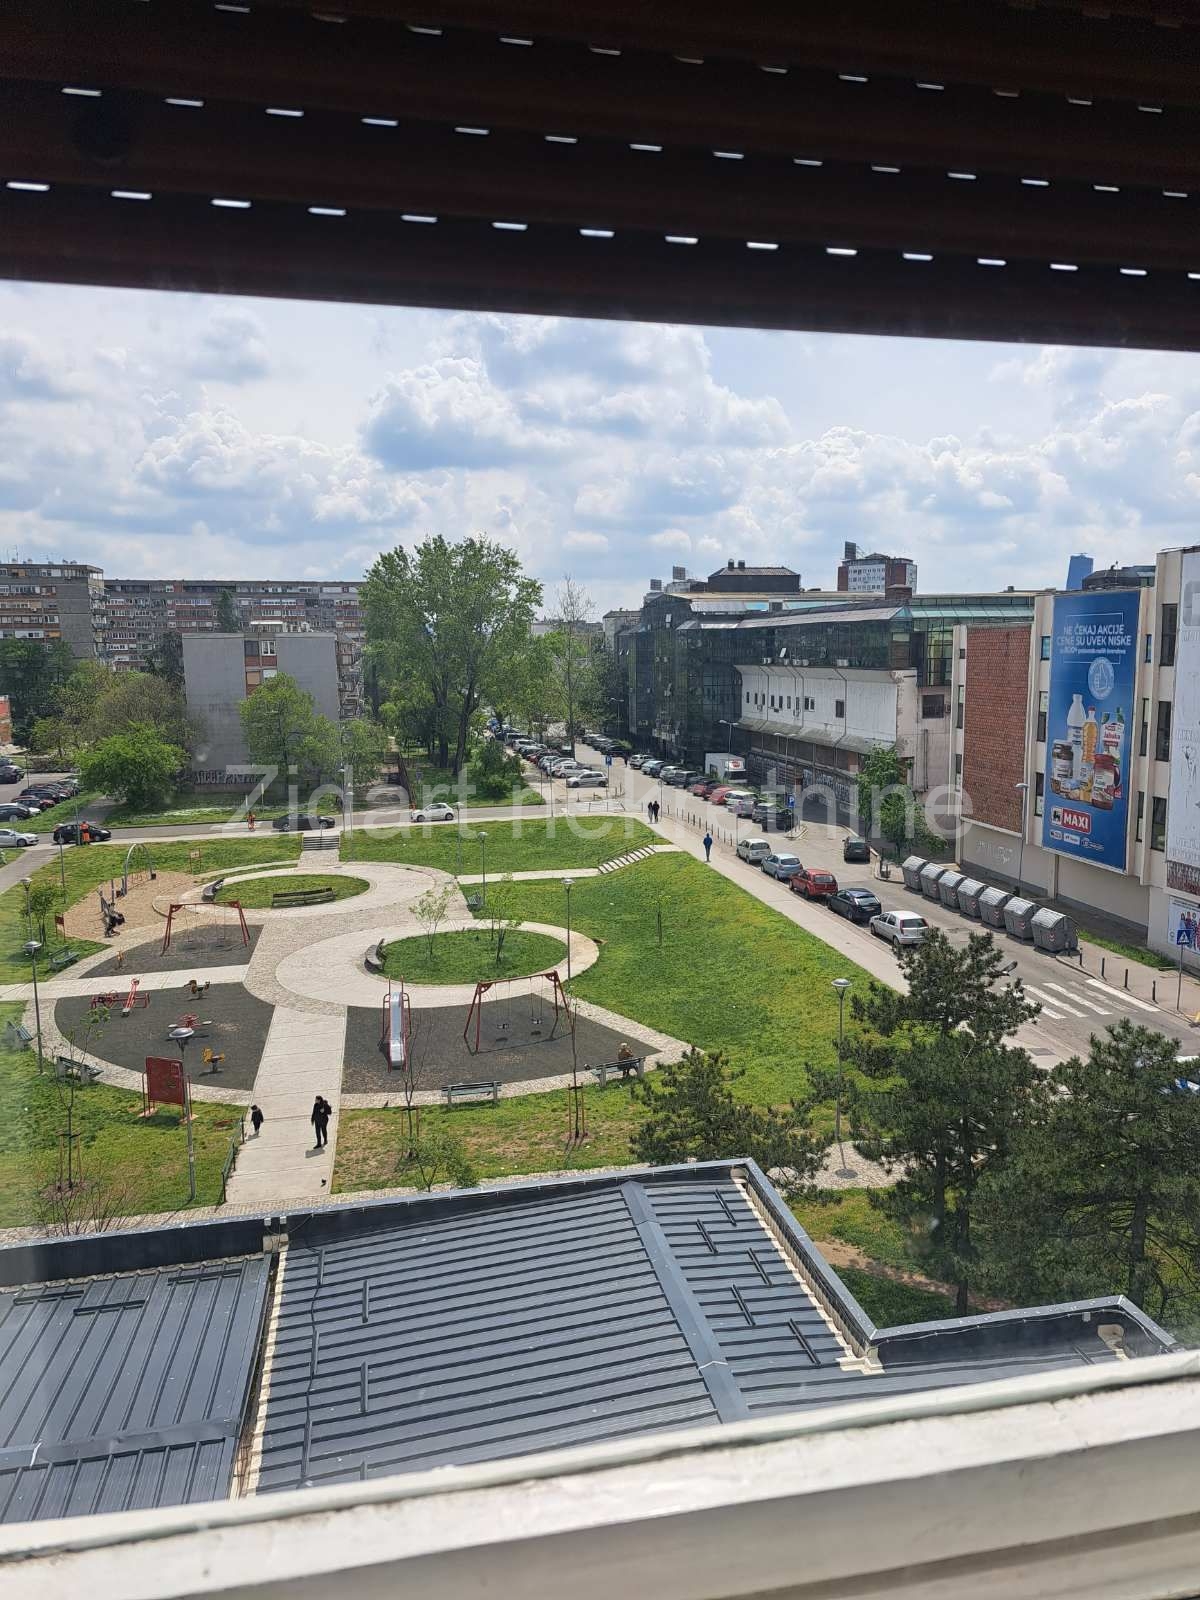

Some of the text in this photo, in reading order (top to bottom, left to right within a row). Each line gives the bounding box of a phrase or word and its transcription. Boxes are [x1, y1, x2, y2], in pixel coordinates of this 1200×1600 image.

[1063, 623, 1125, 635] NE ČEKAJ AKCIJE
[1057, 635, 1132, 646] CENE SU UVEK NISKE
[1063, 812, 1089, 830] MAXI
